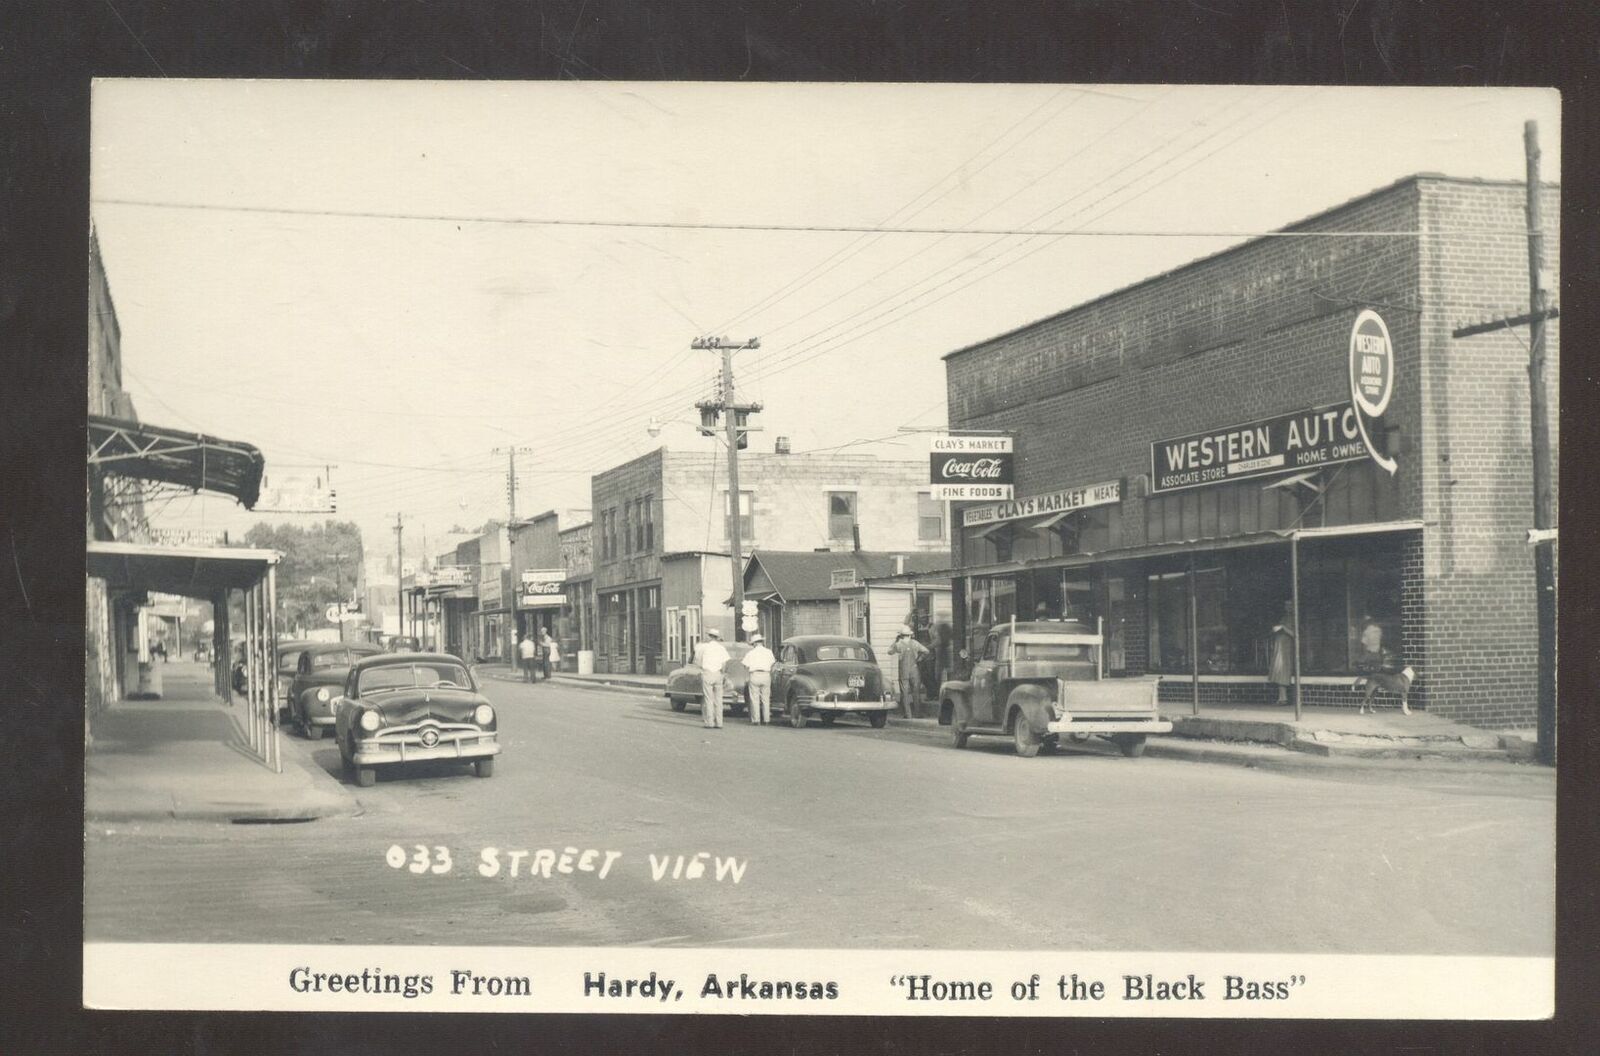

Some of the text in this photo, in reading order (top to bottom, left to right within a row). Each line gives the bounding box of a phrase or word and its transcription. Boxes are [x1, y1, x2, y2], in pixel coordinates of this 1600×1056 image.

[969, 440, 1006, 450] MARKET
[1166, 426, 1270, 471] WESTERN
[1297, 441, 1367, 465] HOME OWNE
[942, 458, 1002, 478] Coca-Cola
[1161, 467, 1225, 488] ASSOCIATE STORE
[943, 487, 1002, 497] FINE FOODS
[997, 500, 1034, 519] CLAYS
[1037, 490, 1087, 513] MARKET
[1094, 484, 1120, 500] MEATS
